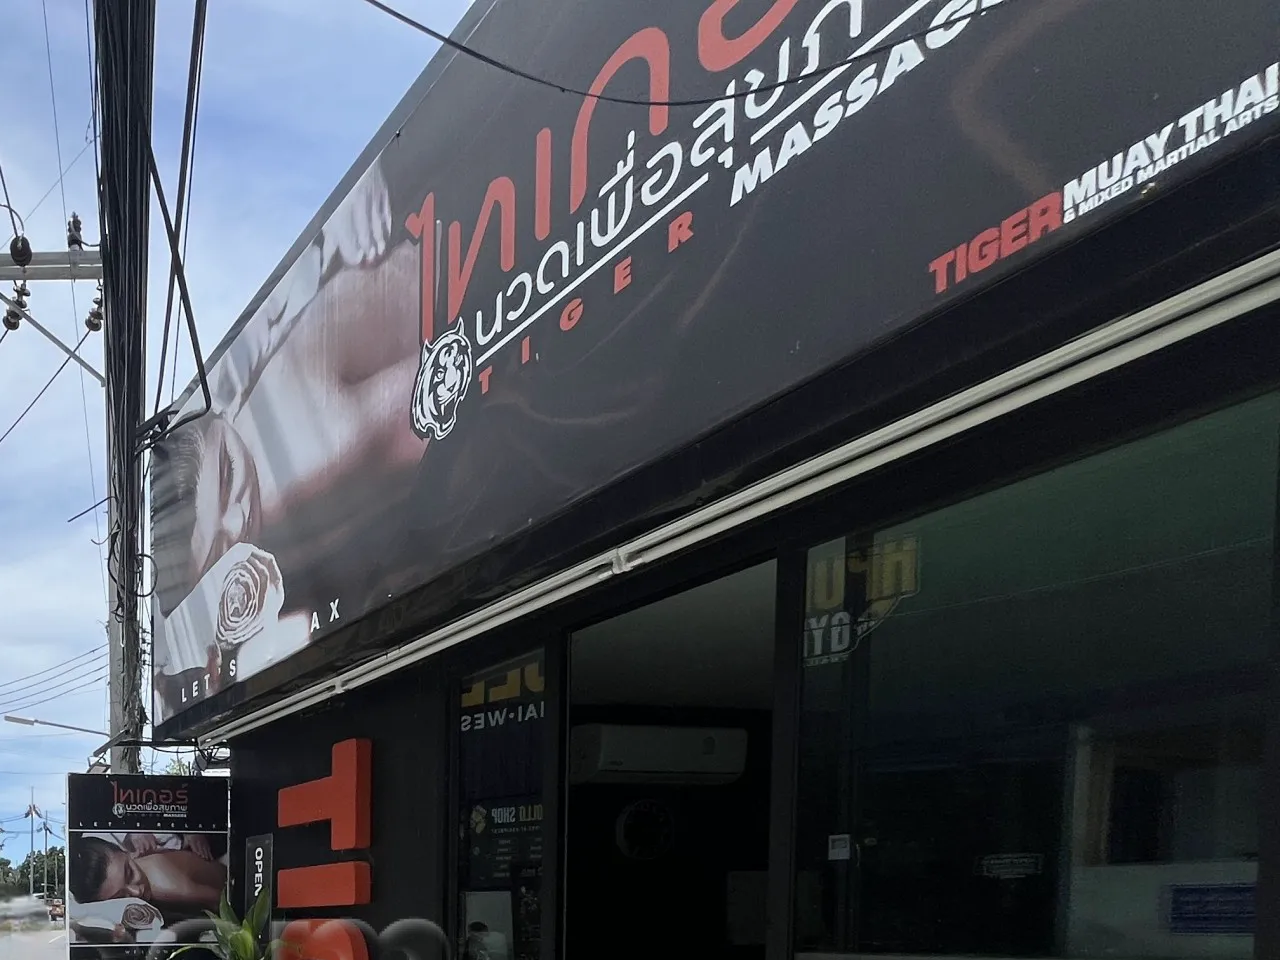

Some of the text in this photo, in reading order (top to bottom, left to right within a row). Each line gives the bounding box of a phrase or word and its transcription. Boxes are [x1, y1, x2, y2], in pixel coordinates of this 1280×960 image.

[729, 0, 1006, 208] MASSAG
[929, 61, 1280, 294] TIGER MUAY THAI
[1078, 175, 1133, 216] MIXED
[1136, 130, 1222, 185] MARTIAL
[1223, 95, 1280, 137] ARTS
[478, 210, 695, 395] TIGER
[254, 847, 264, 897] OPEN
